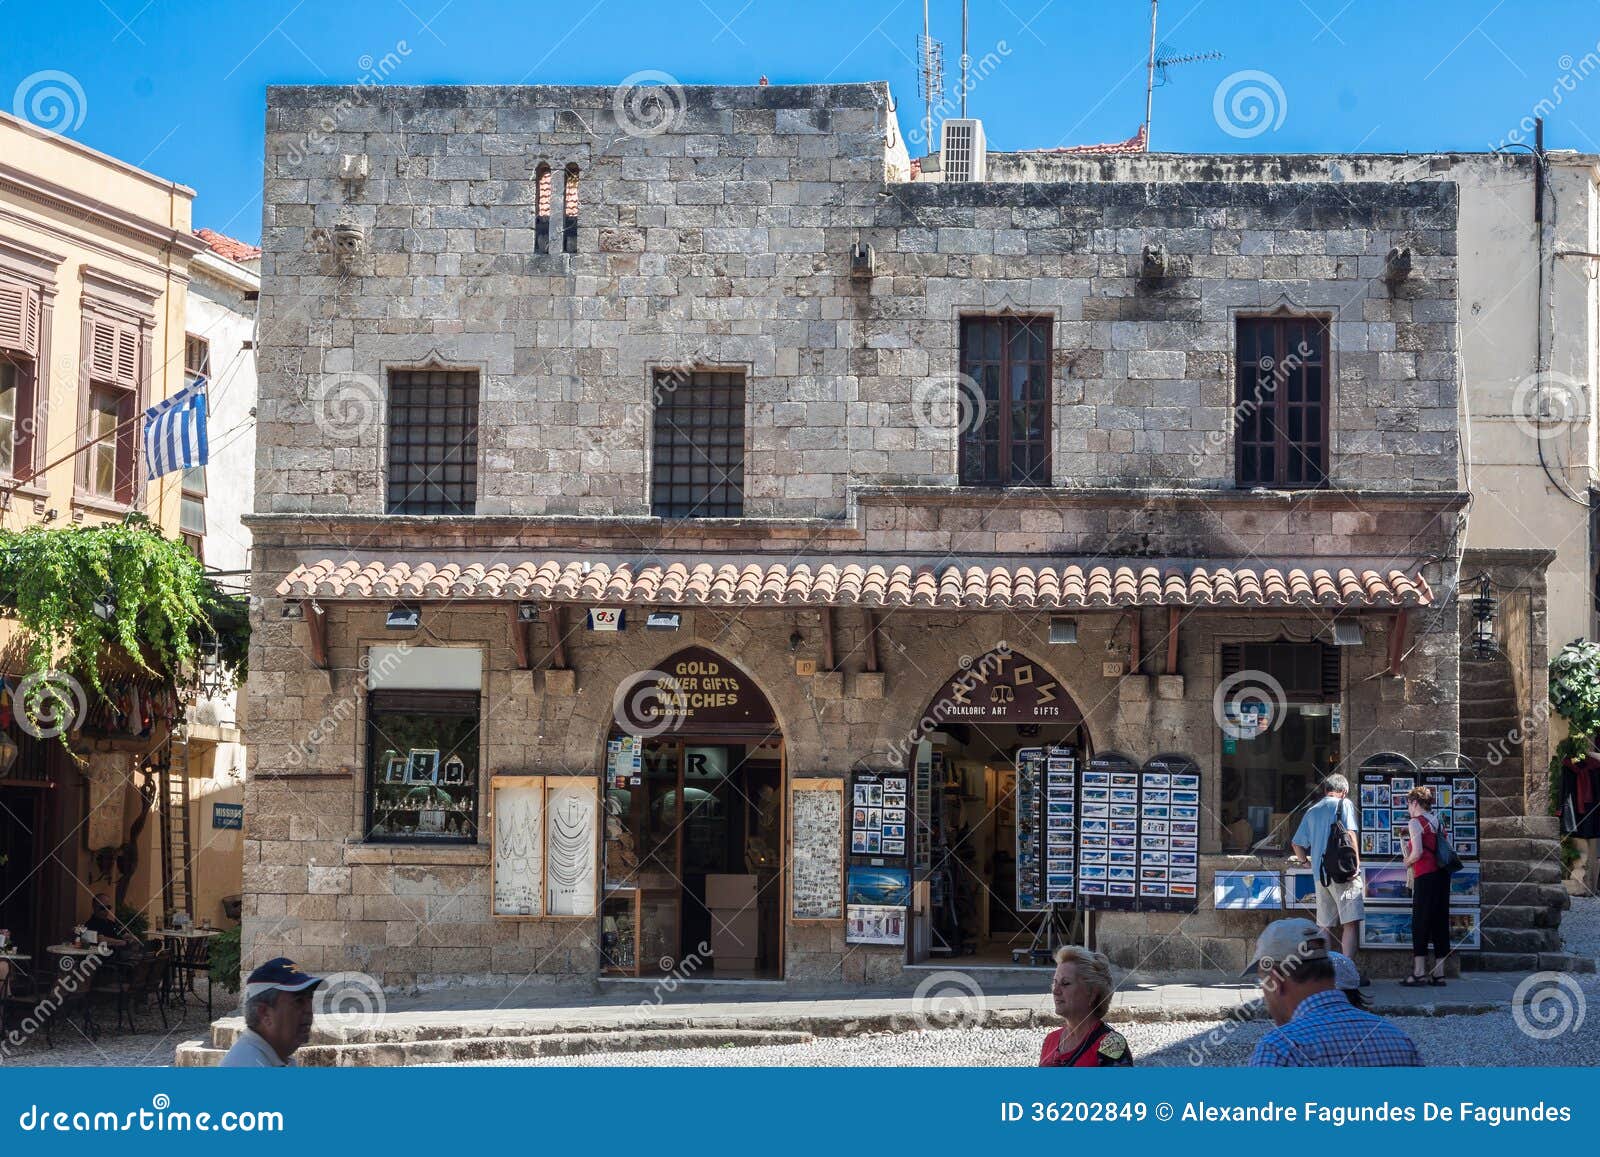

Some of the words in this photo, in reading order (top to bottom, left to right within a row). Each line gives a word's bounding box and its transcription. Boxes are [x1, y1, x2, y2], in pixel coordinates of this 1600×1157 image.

[675, 662, 719, 675] GOLD
[655, 677, 698, 691] SILVER
[702, 677, 740, 691] GIFTS
[656, 692, 738, 708] WATCHES
[650, 708, 694, 717] GEORGE
[947, 706, 986, 716] FOLKLORIC
[991, 706, 1008, 716] ART
[1033, 706, 1060, 716] GIFTS
